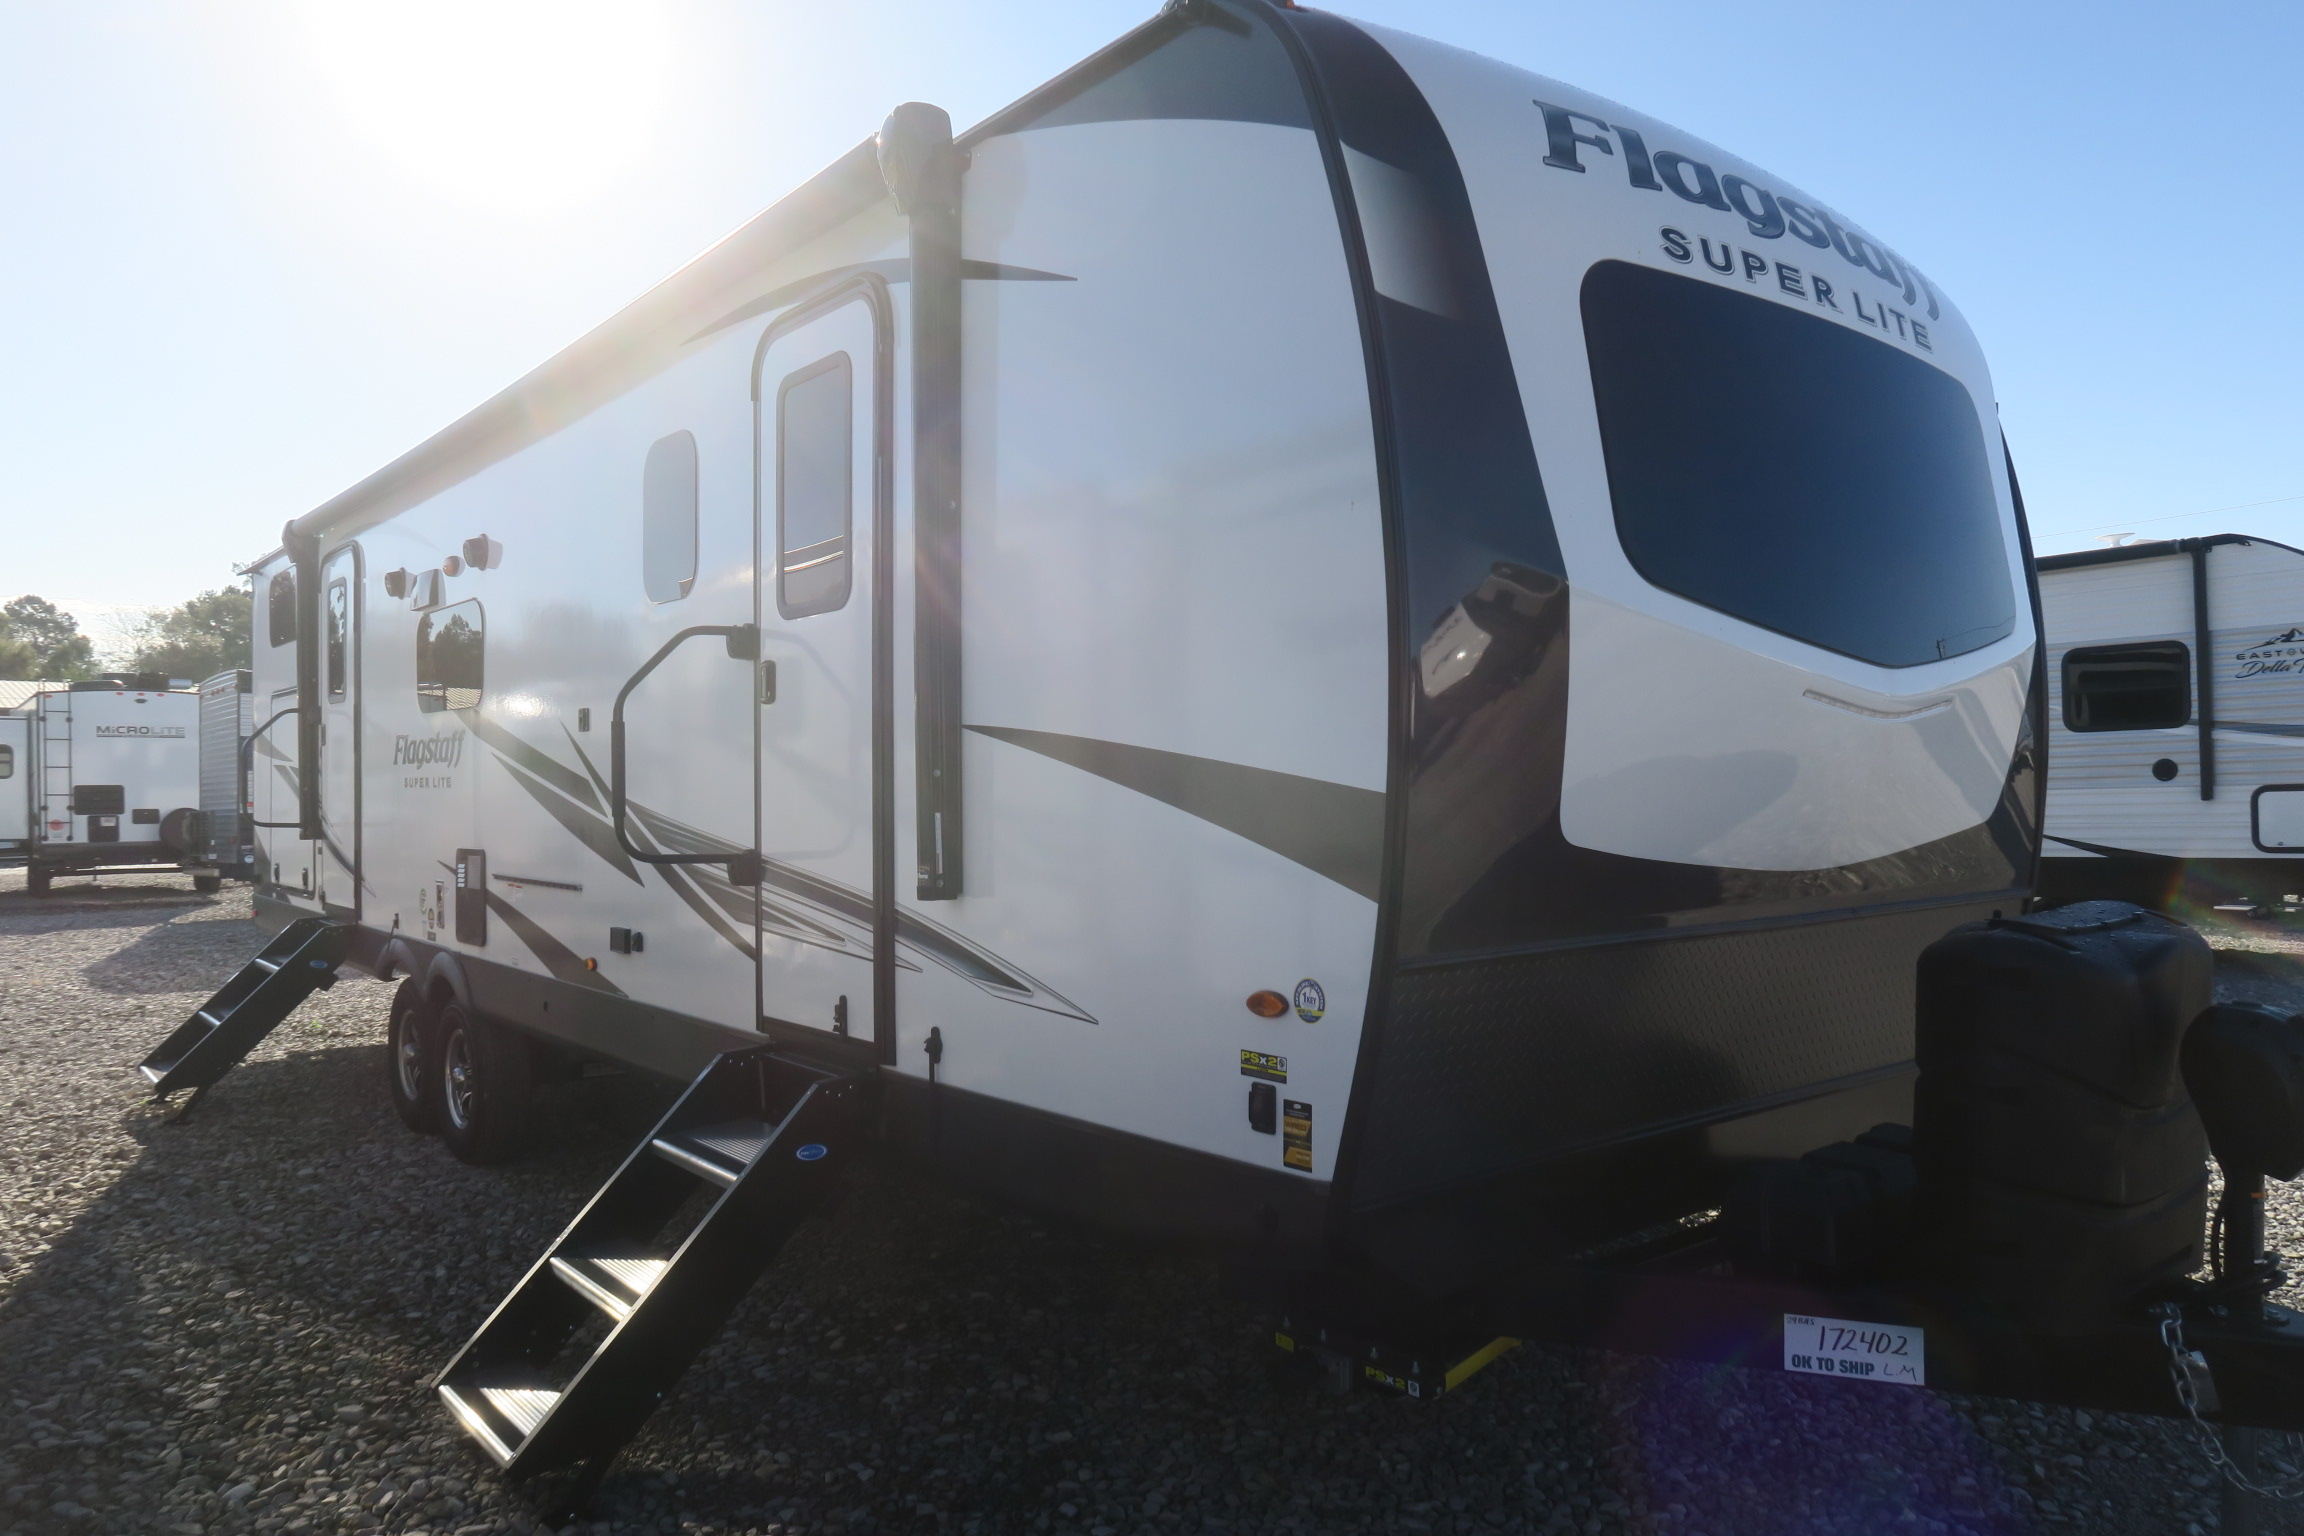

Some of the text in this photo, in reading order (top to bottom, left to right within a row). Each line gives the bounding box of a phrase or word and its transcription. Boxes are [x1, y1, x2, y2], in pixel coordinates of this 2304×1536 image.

[1658, 225, 1934, 353] SUPER LITE
[2235, 660, 2291, 678] Della
[393, 728, 466, 770] Flagstaff
[404, 777, 452, 788] SUPER LITE
[1819, 1325, 1908, 1356] 172402
[1791, 1354, 1875, 1376] OK TO SHIP
